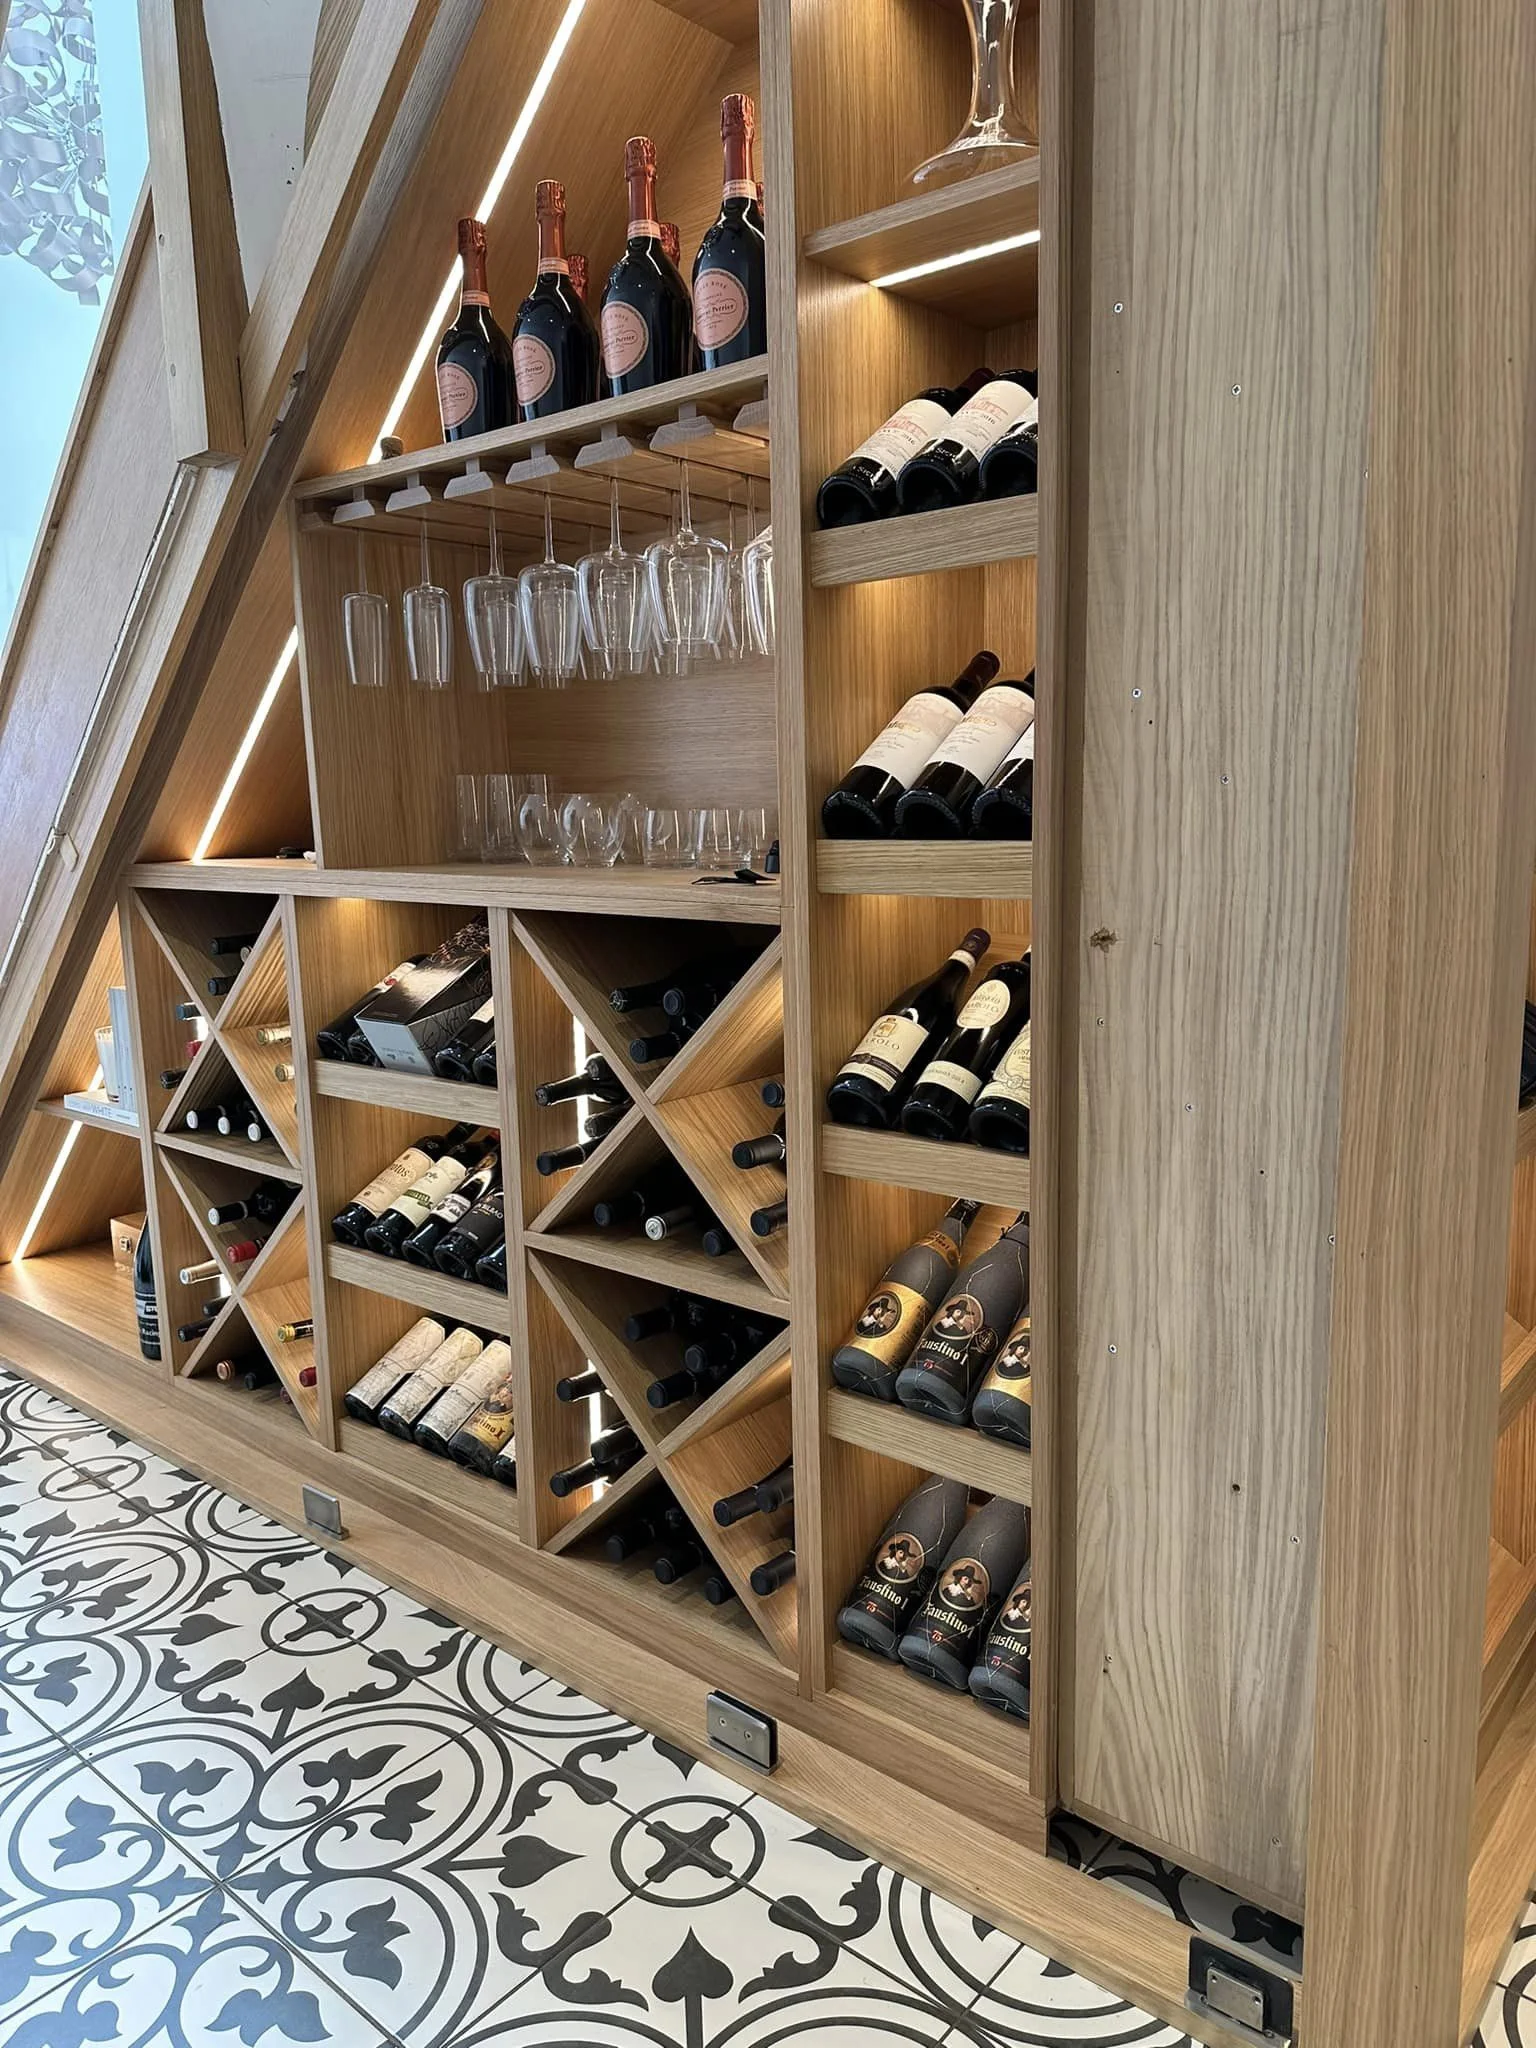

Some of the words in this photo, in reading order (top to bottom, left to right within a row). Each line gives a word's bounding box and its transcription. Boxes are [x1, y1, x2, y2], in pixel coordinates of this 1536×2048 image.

[918, 1338, 961, 1360] Faustino
[859, 1576, 902, 1605] Faustino
[921, 1602, 968, 1632] Faustino
[988, 1632, 1028, 1655] austino
